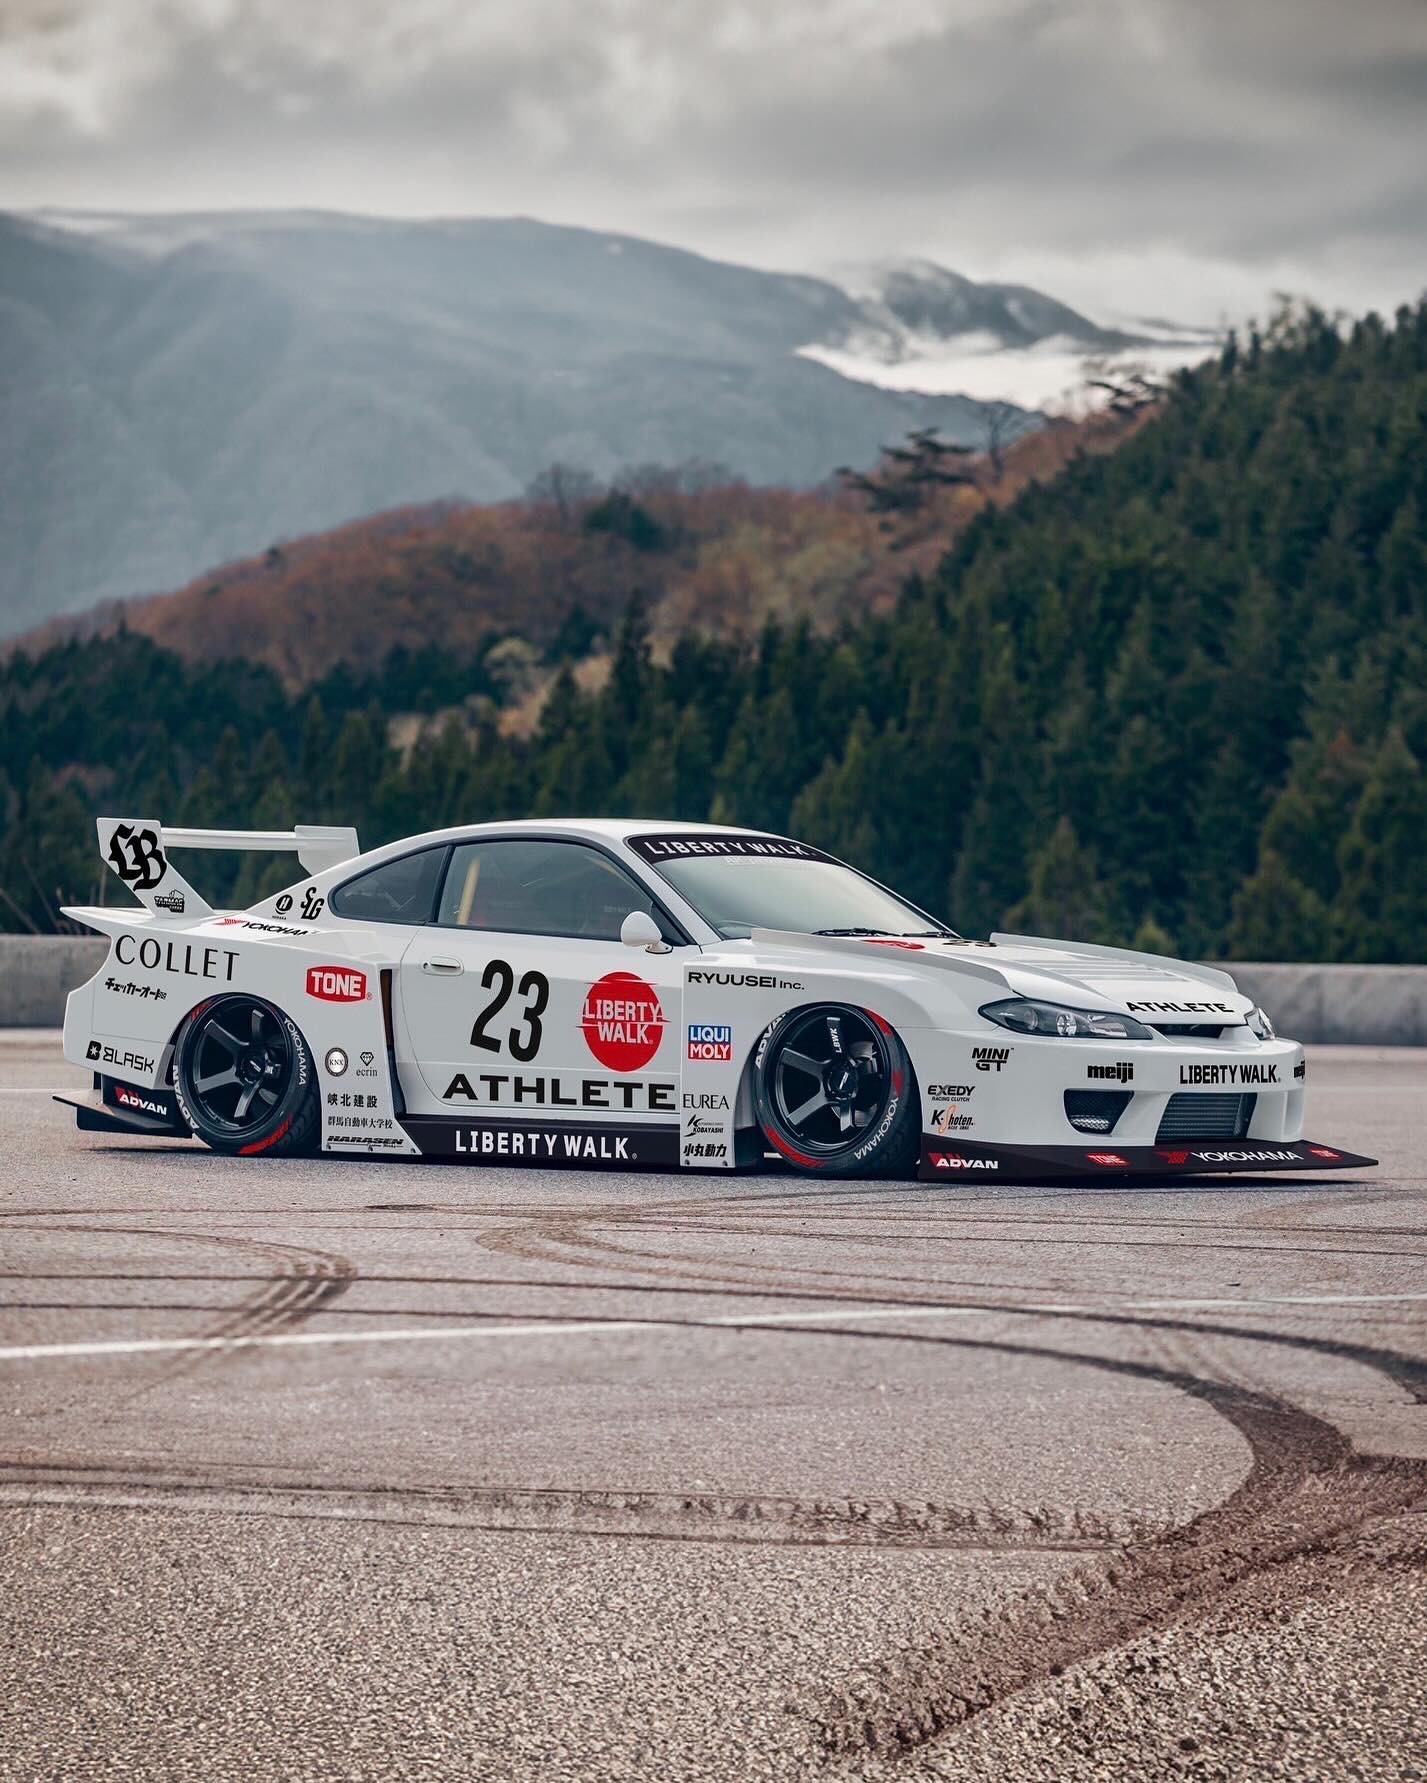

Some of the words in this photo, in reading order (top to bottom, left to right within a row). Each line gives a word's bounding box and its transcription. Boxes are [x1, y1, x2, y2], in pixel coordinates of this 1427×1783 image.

[645, 841, 746, 855] LIBERTY
[747, 842, 808, 856] WALK
[115, 934, 240, 981] COLLET
[311, 971, 362, 997] TONE
[688, 971, 777, 989] RYUUSEI
[779, 979, 805, 991] Inc.
[470, 959, 549, 1062] 23
[584, 998, 661, 1024] LIBERTY
[1125, 1000, 1235, 1014] ATHLETE
[597, 1021, 650, 1045] WALK
[690, 1026, 729, 1044] LIQUI
[755, 1010, 790, 1069] ADVA
[829, 1027, 842, 1053] LBWK
[103, 1046, 154, 1074] BLASK
[283, 1017, 307, 1086] YOKOHAMA
[690, 1043, 730, 1060] MOLY
[971, 1047, 1010, 1060] MINI
[356, 1066, 378, 1078] ecrin
[975, 1059, 1007, 1072] GT
[1087, 1062, 1134, 1083] meiji
[1179, 1064, 1238, 1085] LIBERTY
[1239, 1064, 1277, 1084] WALK
[442, 1073, 677, 1111] ATHLETE
[927, 1084, 976, 1097] EXEDY
[119, 1093, 168, 1116] ADVAN
[682, 1093, 730, 1110] EUREA
[692, 1126, 725, 1134] KOBAYASHI
[854, 1097, 899, 1160] YOKOHAMA
[455, 1130, 560, 1156] LIBERTY
[563, 1134, 629, 1160] WALK
[683, 1143, 728, 1158] 小丸動力
[936, 1157, 999, 1169] ADVAN
[1191, 1150, 1304, 1162] YOKOHAMA
